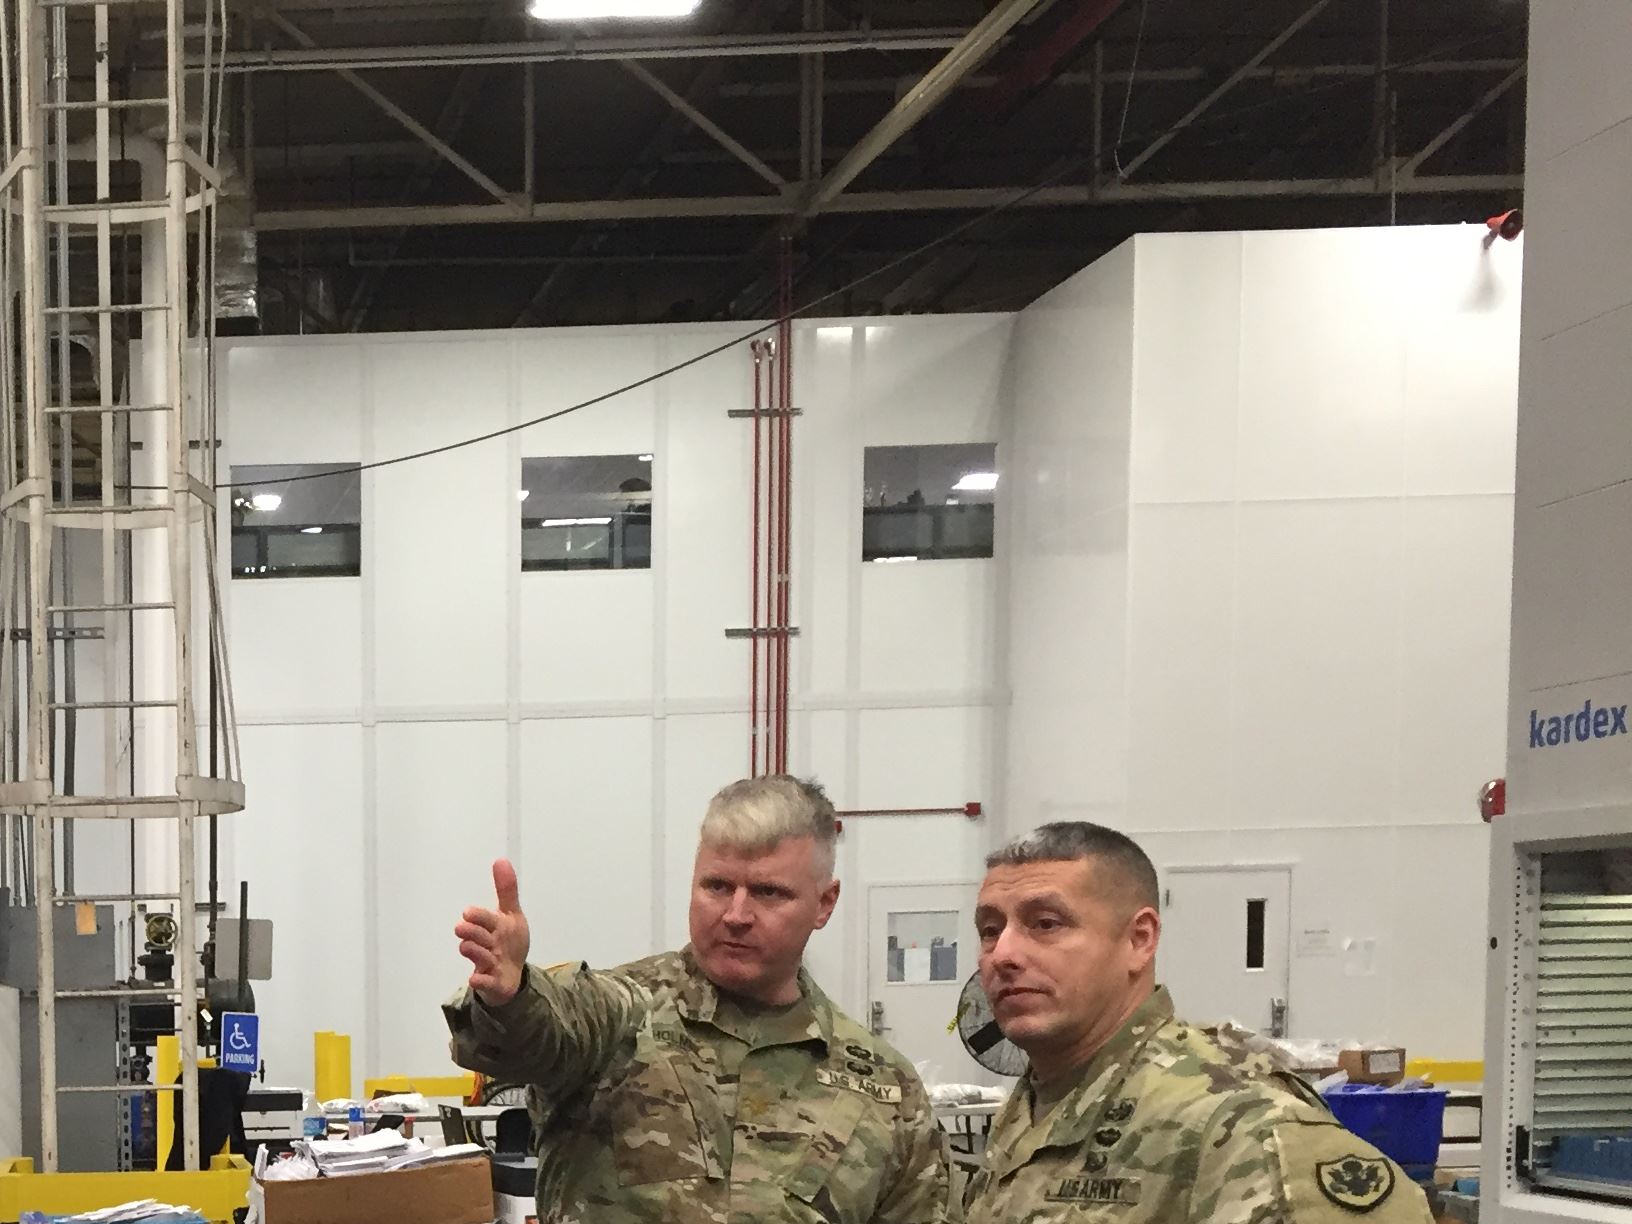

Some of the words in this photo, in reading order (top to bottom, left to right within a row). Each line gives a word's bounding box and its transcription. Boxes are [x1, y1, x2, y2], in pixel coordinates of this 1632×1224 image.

[1529, 698, 1628, 749] kardex
[225, 1052, 256, 1065] PARKING
[858, 1080, 892, 1100] ARMY
[1079, 1179, 1123, 1200] ARMY
